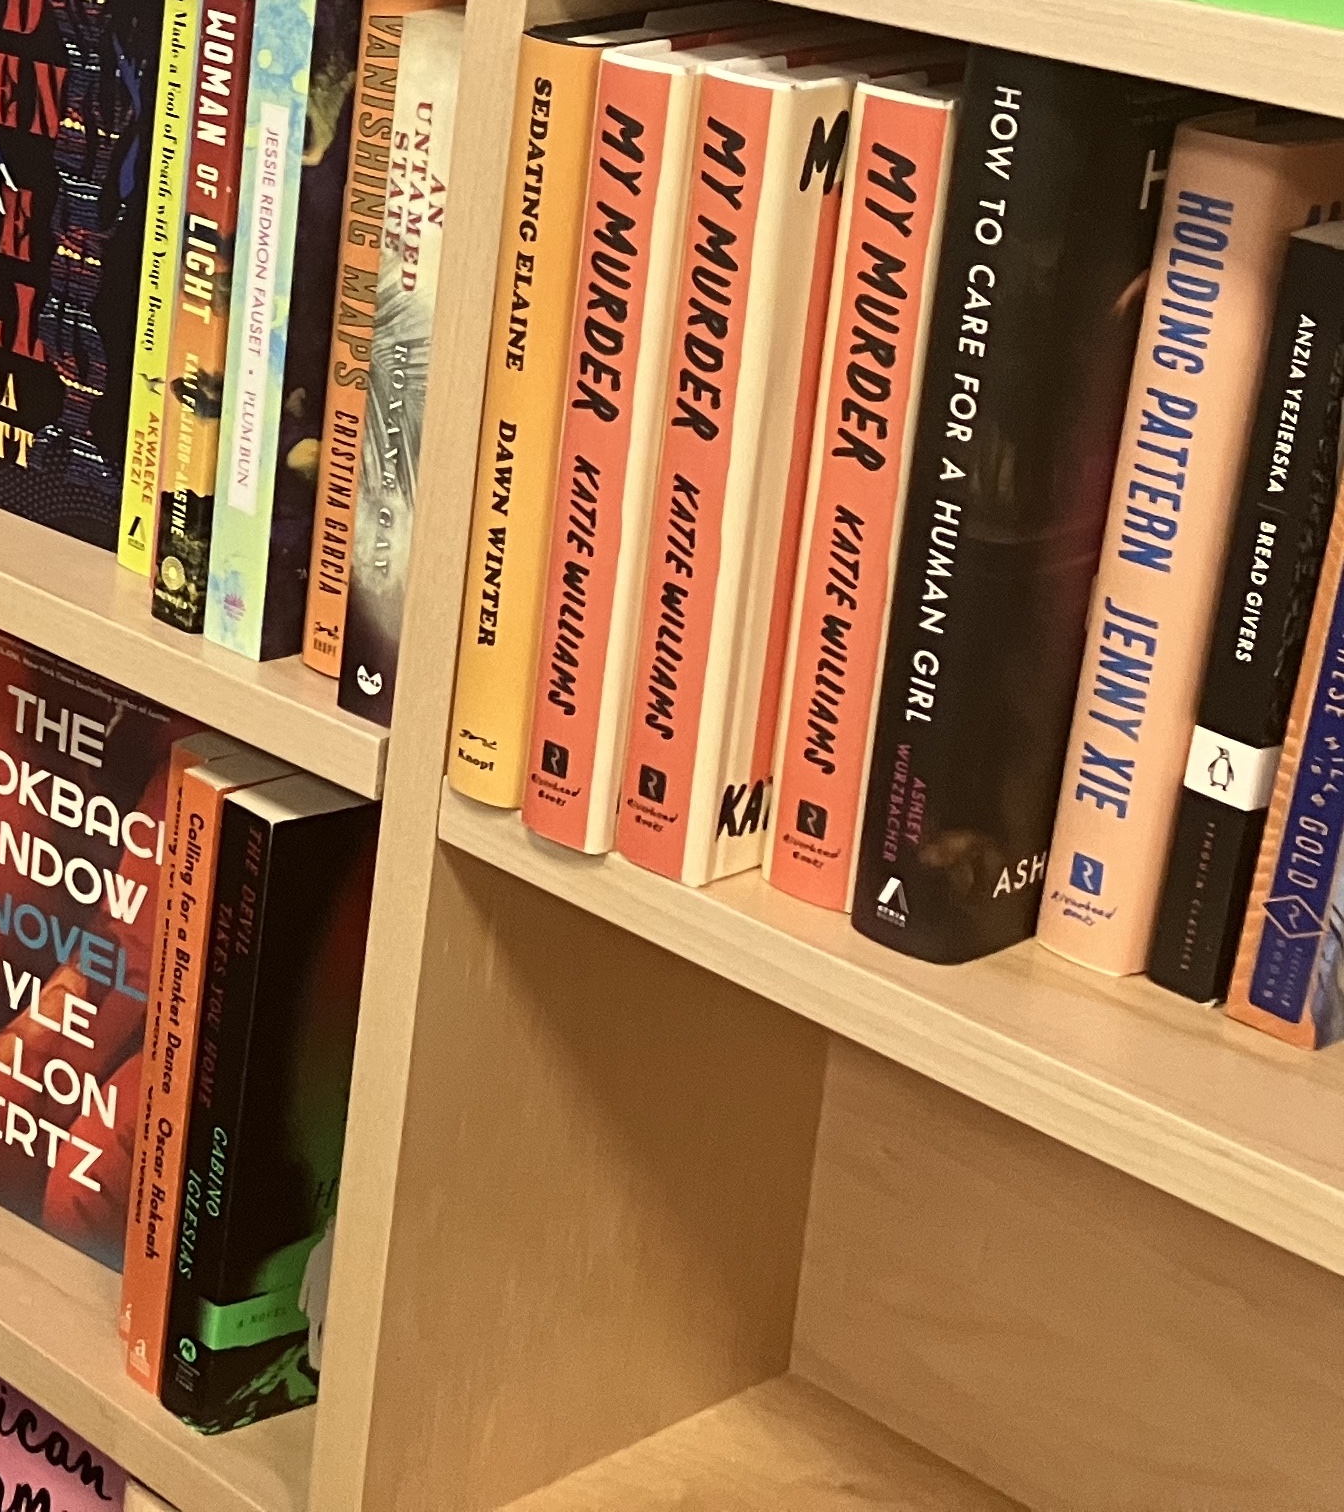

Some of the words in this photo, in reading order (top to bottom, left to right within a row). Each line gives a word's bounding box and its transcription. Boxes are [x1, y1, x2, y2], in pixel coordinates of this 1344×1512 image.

[196, 8, 237, 147] WOMAN
[261, 127, 280, 188] JESSIE
[518, 76, 553, 243] SEDATING
[598, 104, 645, 197] MY
[699, 116, 747, 212] MY
[983, 85, 1022, 181] HOW
[195, 163, 219, 200] OF
[383, 132, 411, 253] STATE
[401, 101, 434, 293] UNTAMED
[427, 174, 448, 228] AN
[865, 142, 918, 238] MY
[975, 199, 1007, 246] TO
[179, 215, 218, 325] LIGHT
[255, 194, 275, 281] REDMON
[1152, 191, 1235, 376] HOLDING
[247, 288, 267, 358] FAUSET
[506, 250, 535, 372] ELAINE
[571, 200, 639, 423] MURDER
[670, 215, 739, 442] MURDER
[831, 241, 908, 472] MURDER
[958, 264, 997, 358] CARE
[1289, 313, 1319, 379] ANZIA
[944, 372, 980, 443] FOR
[1266, 388, 1305, 494] YEZIERSKA
[130, 429, 146, 486] EMEZI
[141, 411, 160, 505] AKWAEKE
[491, 419, 517, 517] DAWN
[935, 457, 967, 481] A
[1117, 387, 1200, 574] PATTERN
[566, 454, 602, 558] KATIE
[665, 472, 702, 579] KATIE
[476, 526, 508, 647] WINTER
[825, 504, 866, 611] KATIE
[917, 499, 963, 635] HUMAN
[1249, 520, 1278, 588] BREAD
[547, 560, 591, 717] WILLIAMS
[644, 580, 690, 742] WILLIAMS
[1087, 596, 1160, 743] JENNY
[1235, 591, 1265, 665] GIVERS
[8, 683, 108, 769] THE
[803, 613, 851, 776] WILLIAMS
[904, 650, 940, 723] GIRL
[457, 746, 495, 772] Knopf
[1075, 742, 1136, 820] XIE
[179, 812, 205, 888] Calling
[245, 826, 263, 877] THE
[1287, 815, 1329, 889] GOLD
[177, 927, 187, 942] a
[179, 892, 197, 923] for
[235, 884, 257, 956] DEVIL
[165, 946, 191, 1026] Blanket
[161, 1030, 183, 1095] Dance
[151, 1116, 173, 1182] Oscar
[144, 1184, 166, 1260] Hokeah
